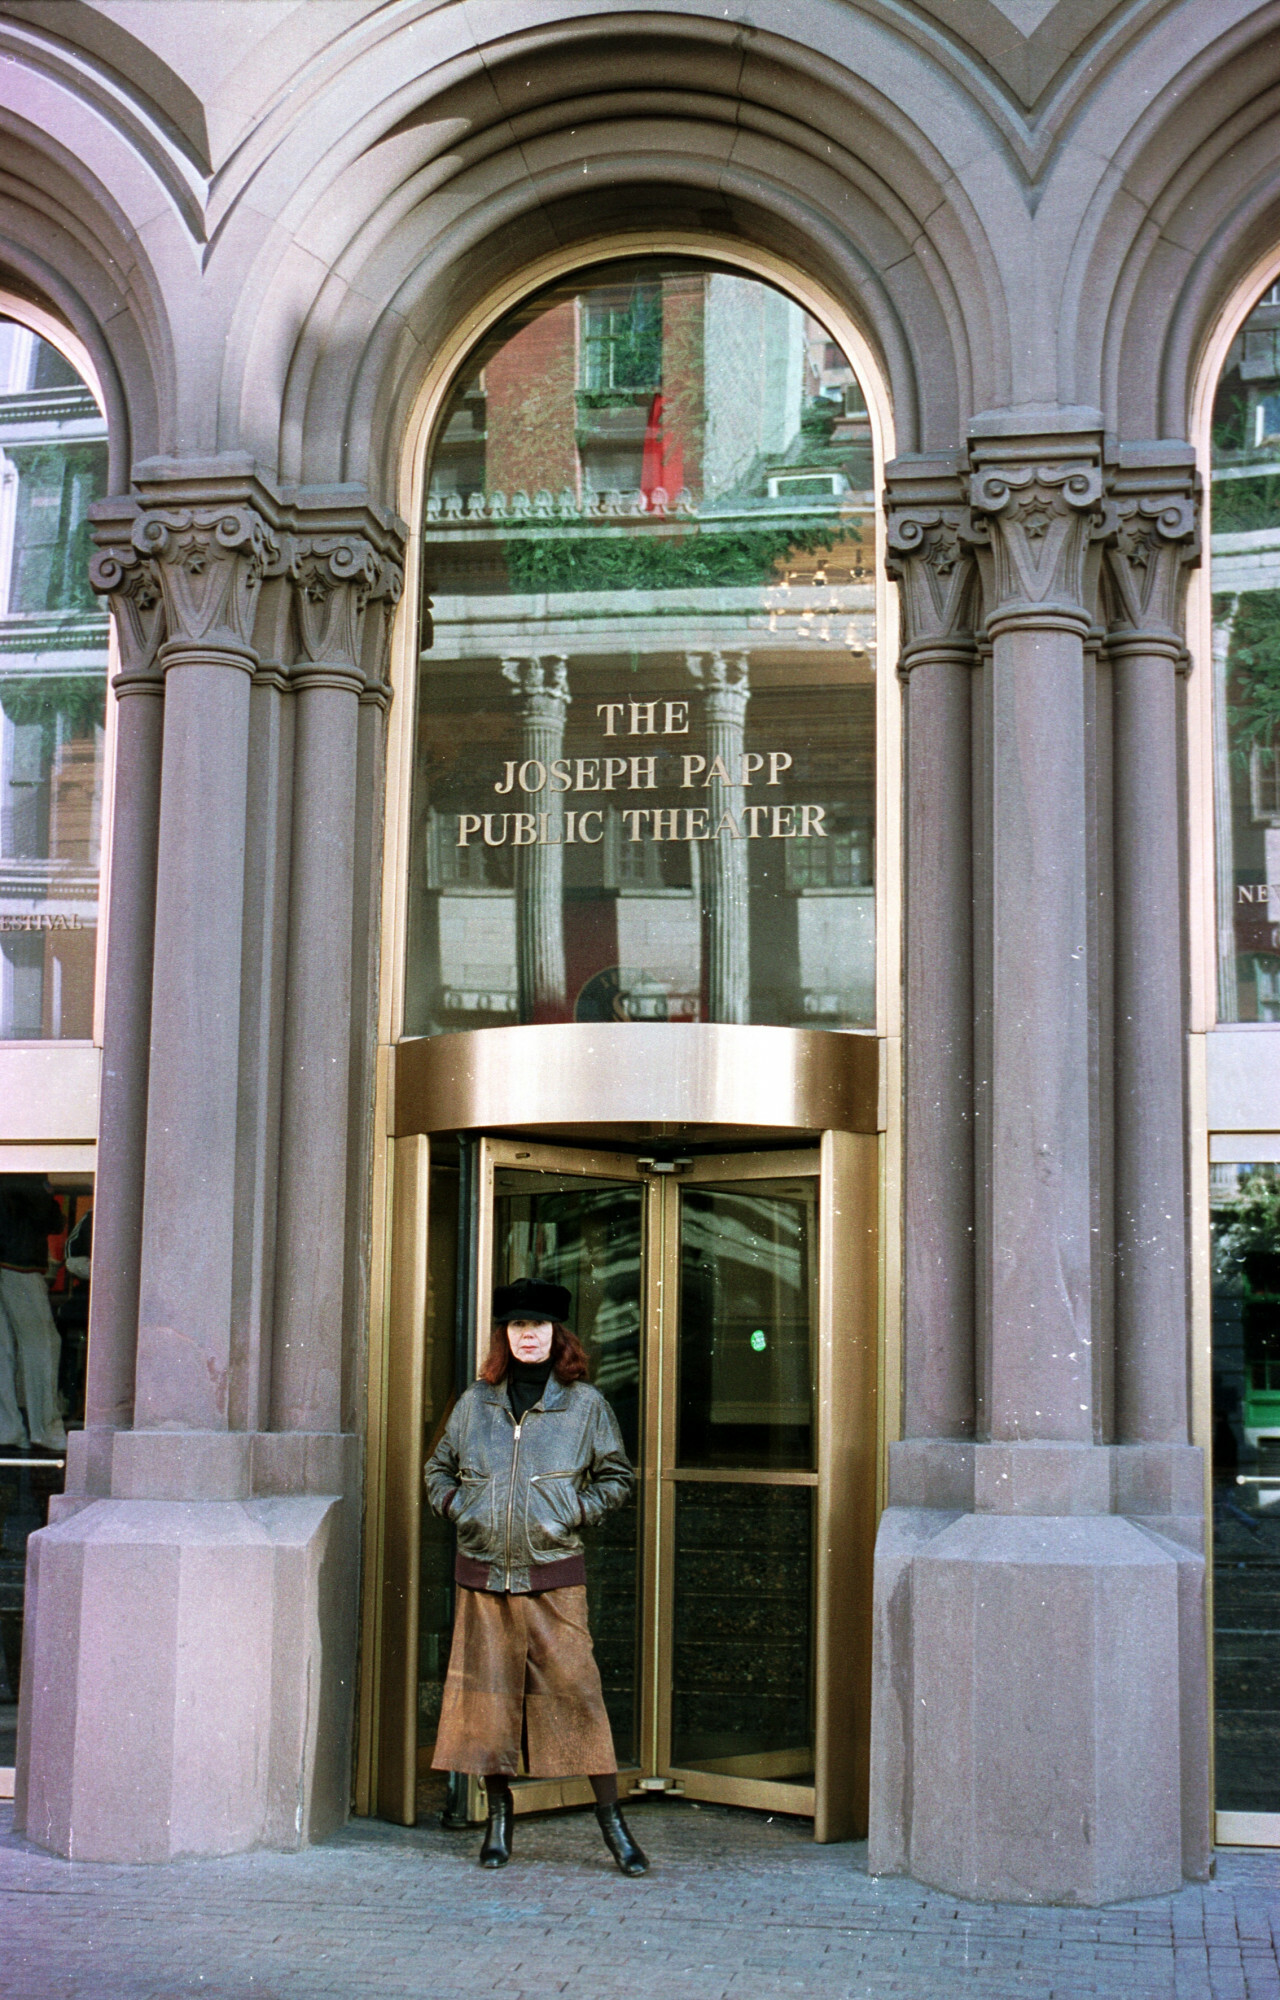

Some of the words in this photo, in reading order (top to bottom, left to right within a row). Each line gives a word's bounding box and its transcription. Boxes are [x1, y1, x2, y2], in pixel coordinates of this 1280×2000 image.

[597, 702, 689, 736] THE
[494, 757, 658, 795] JOSEPH
[680, 752, 793, 787] PAPP
[456, 811, 604, 848] PUBLIC
[622, 805, 829, 842] THEATER
